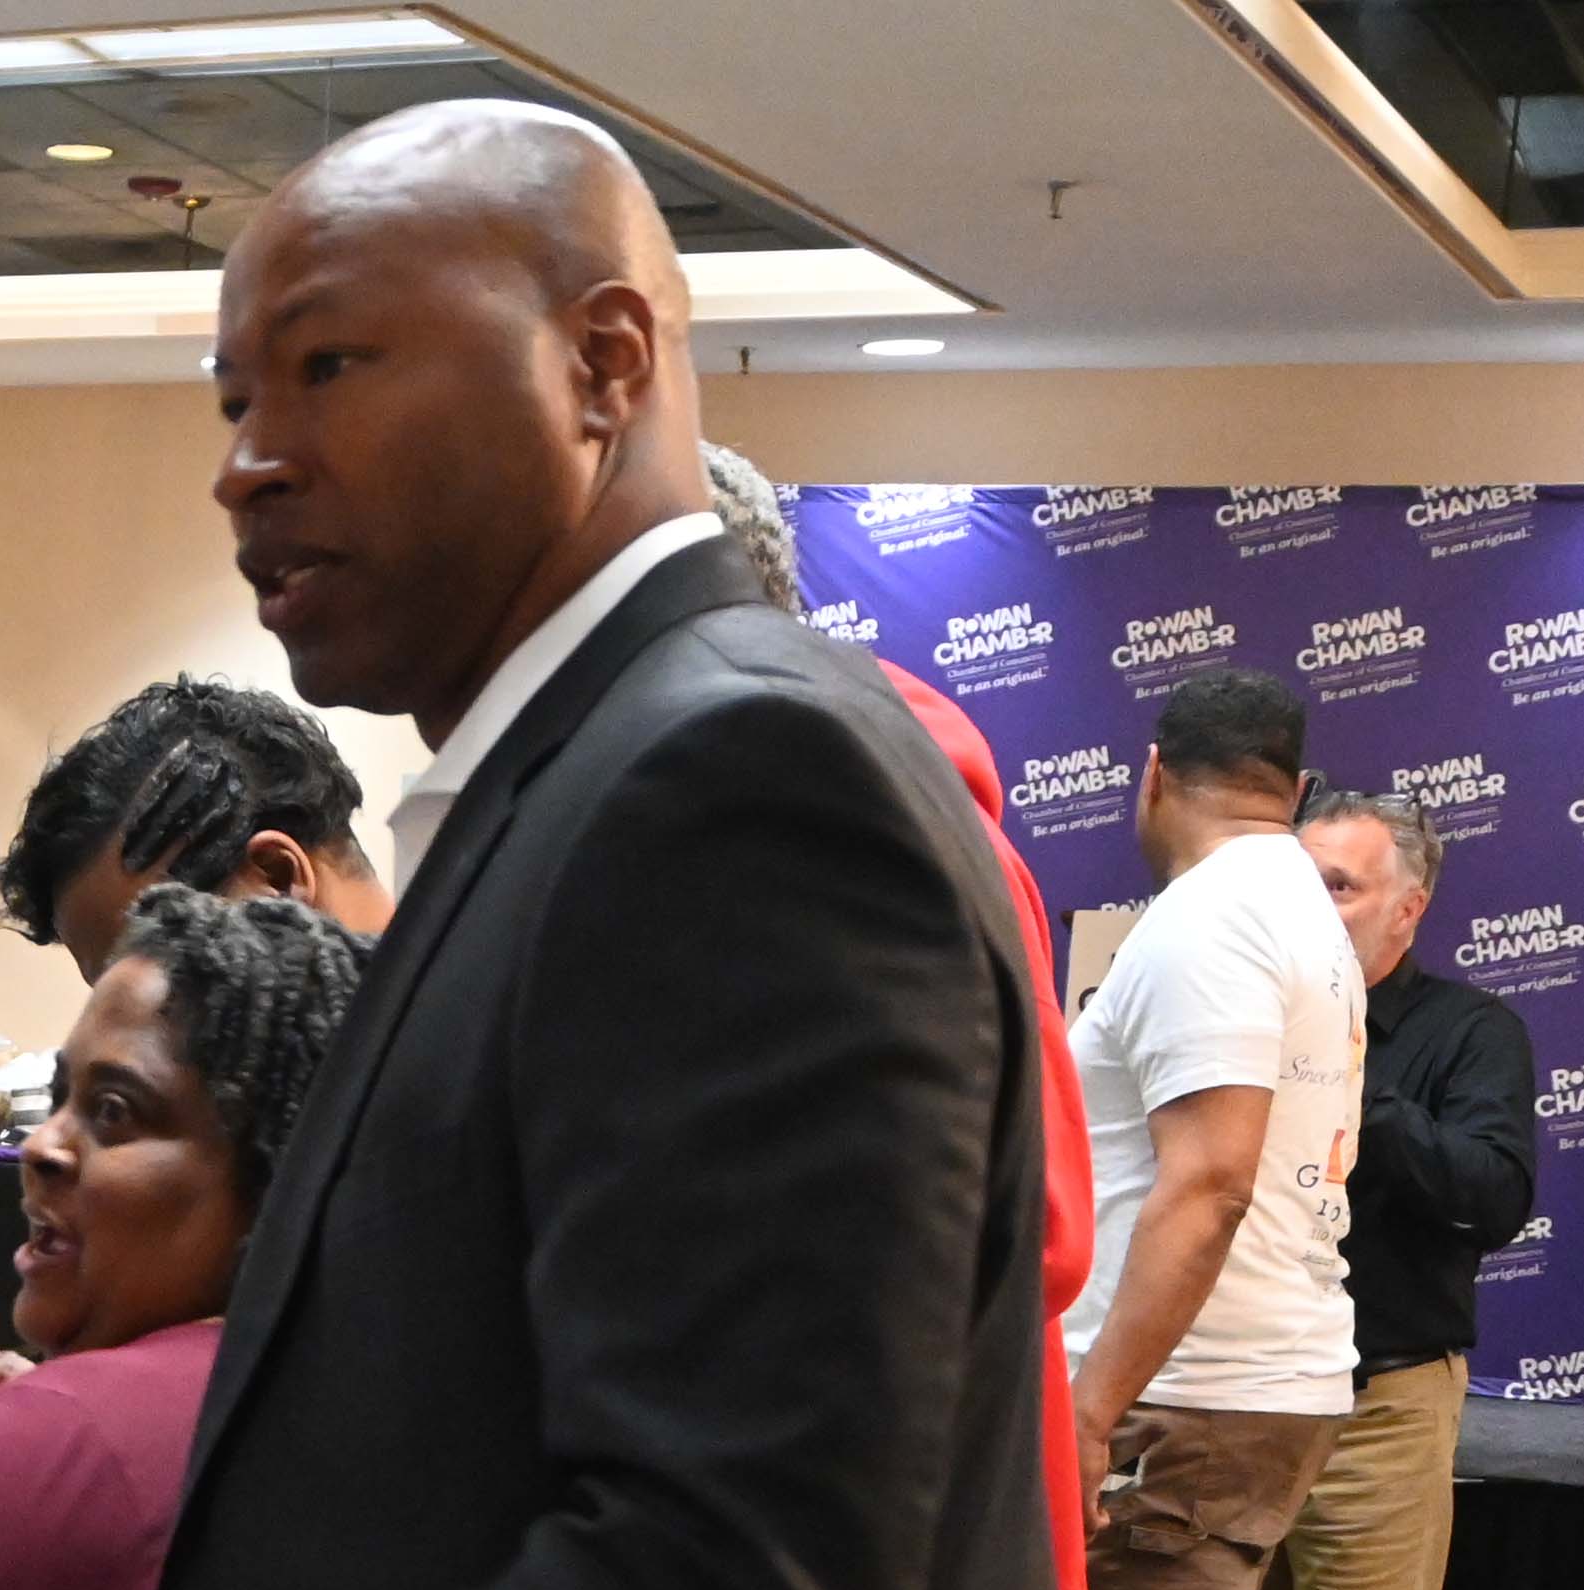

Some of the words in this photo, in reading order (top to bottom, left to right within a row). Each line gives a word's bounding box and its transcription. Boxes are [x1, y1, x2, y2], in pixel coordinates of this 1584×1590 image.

[933, 621, 1054, 667] CHAMBER
[1112, 624, 1236, 667] CHAMBER
[1296, 625, 1426, 671] CHAMBER
[1009, 764, 1131, 806] CHAMBER
[1408, 773, 1506, 809] AMBER
[1455, 924, 1584, 967] CHAMBER
